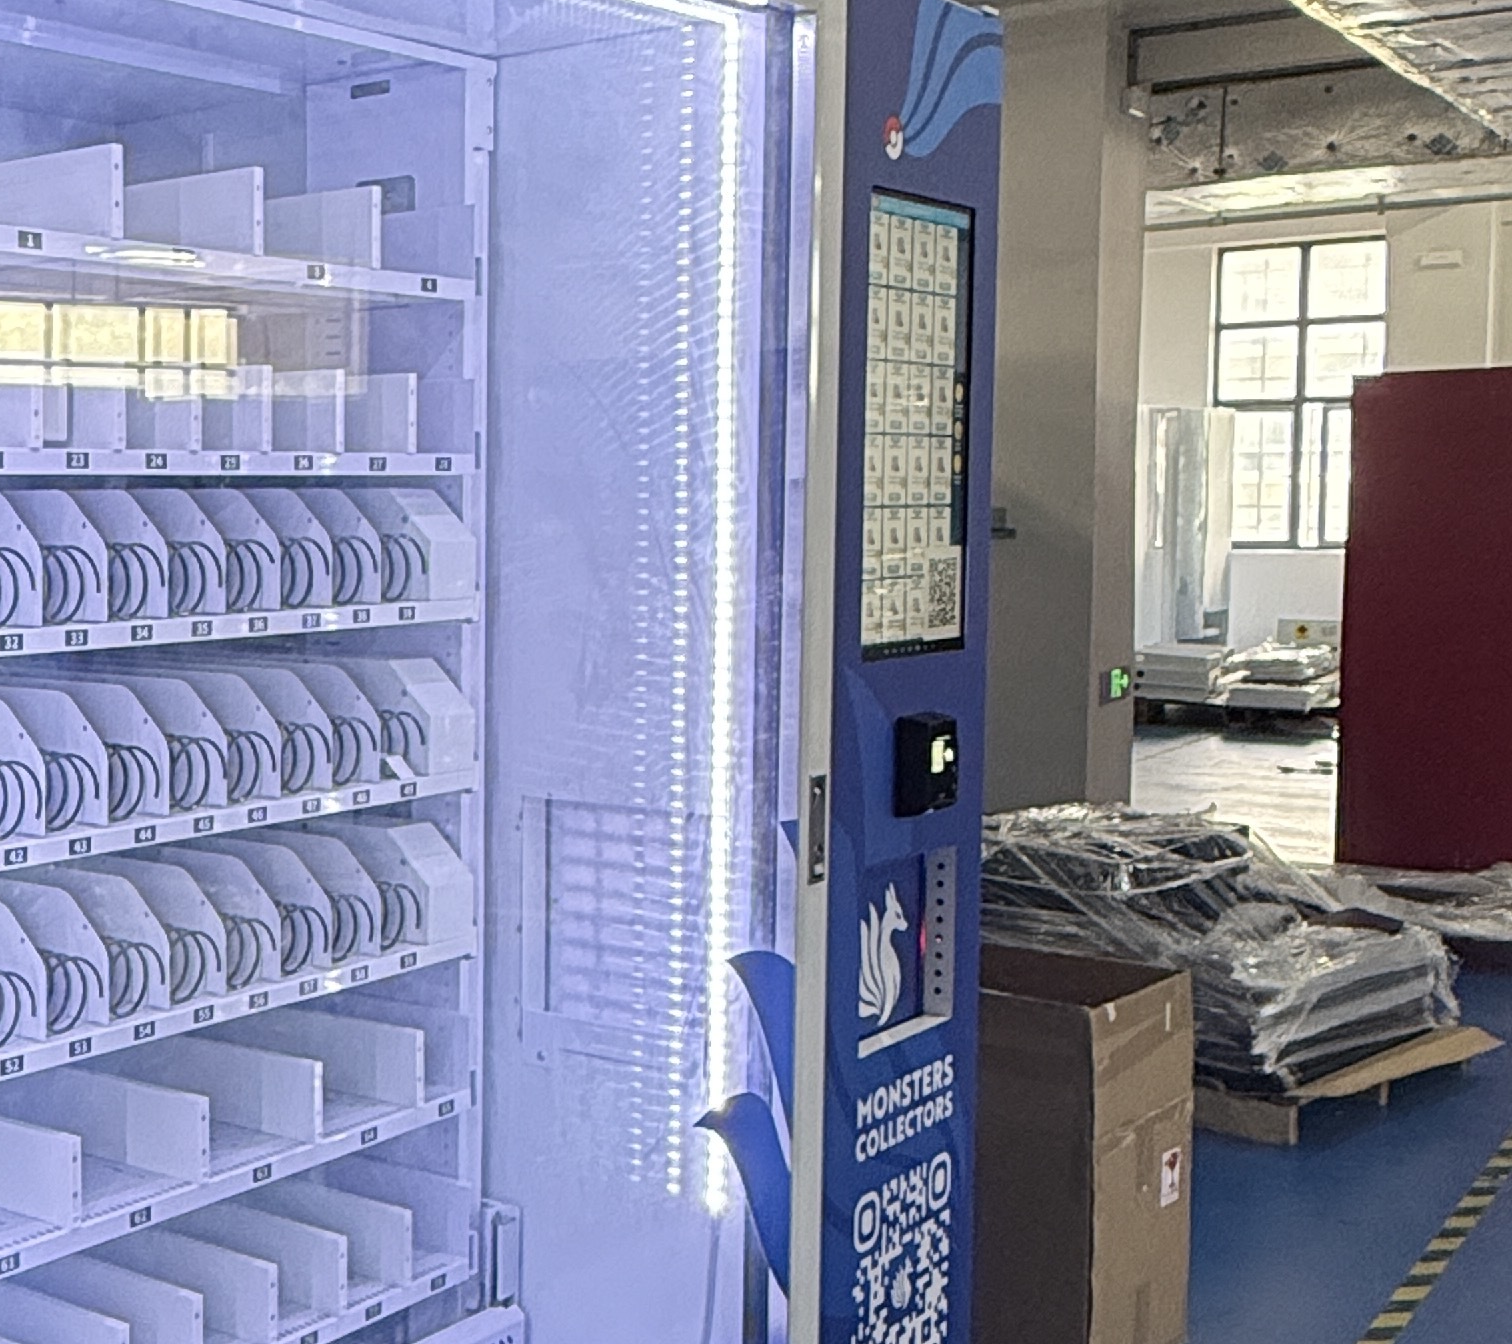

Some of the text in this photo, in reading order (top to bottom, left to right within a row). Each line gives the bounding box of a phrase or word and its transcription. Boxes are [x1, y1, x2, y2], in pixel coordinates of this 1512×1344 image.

[26, 233, 35, 248] 1
[149, 455, 164, 468] 24
[4, 636, 19, 650] 32
[70, 631, 84, 645] 33
[136, 626, 150, 640] 34
[196, 622, 210, 636] 35
[8, 850, 24, 863] 42
[73, 840, 88, 853] 43
[138, 828, 153, 841] 44
[197, 817, 211, 830] 45
[251, 807, 264, 820] 46
[4, 1058, 20, 1074] 52
[138, 1024, 152, 1038] 54
[198, 1007, 211, 1021] 55
[856, 1054, 954, 1130] MONSTERS
[855, 1090, 953, 1163] COLLECTORS
[0, 1256, 16, 1272] 61
